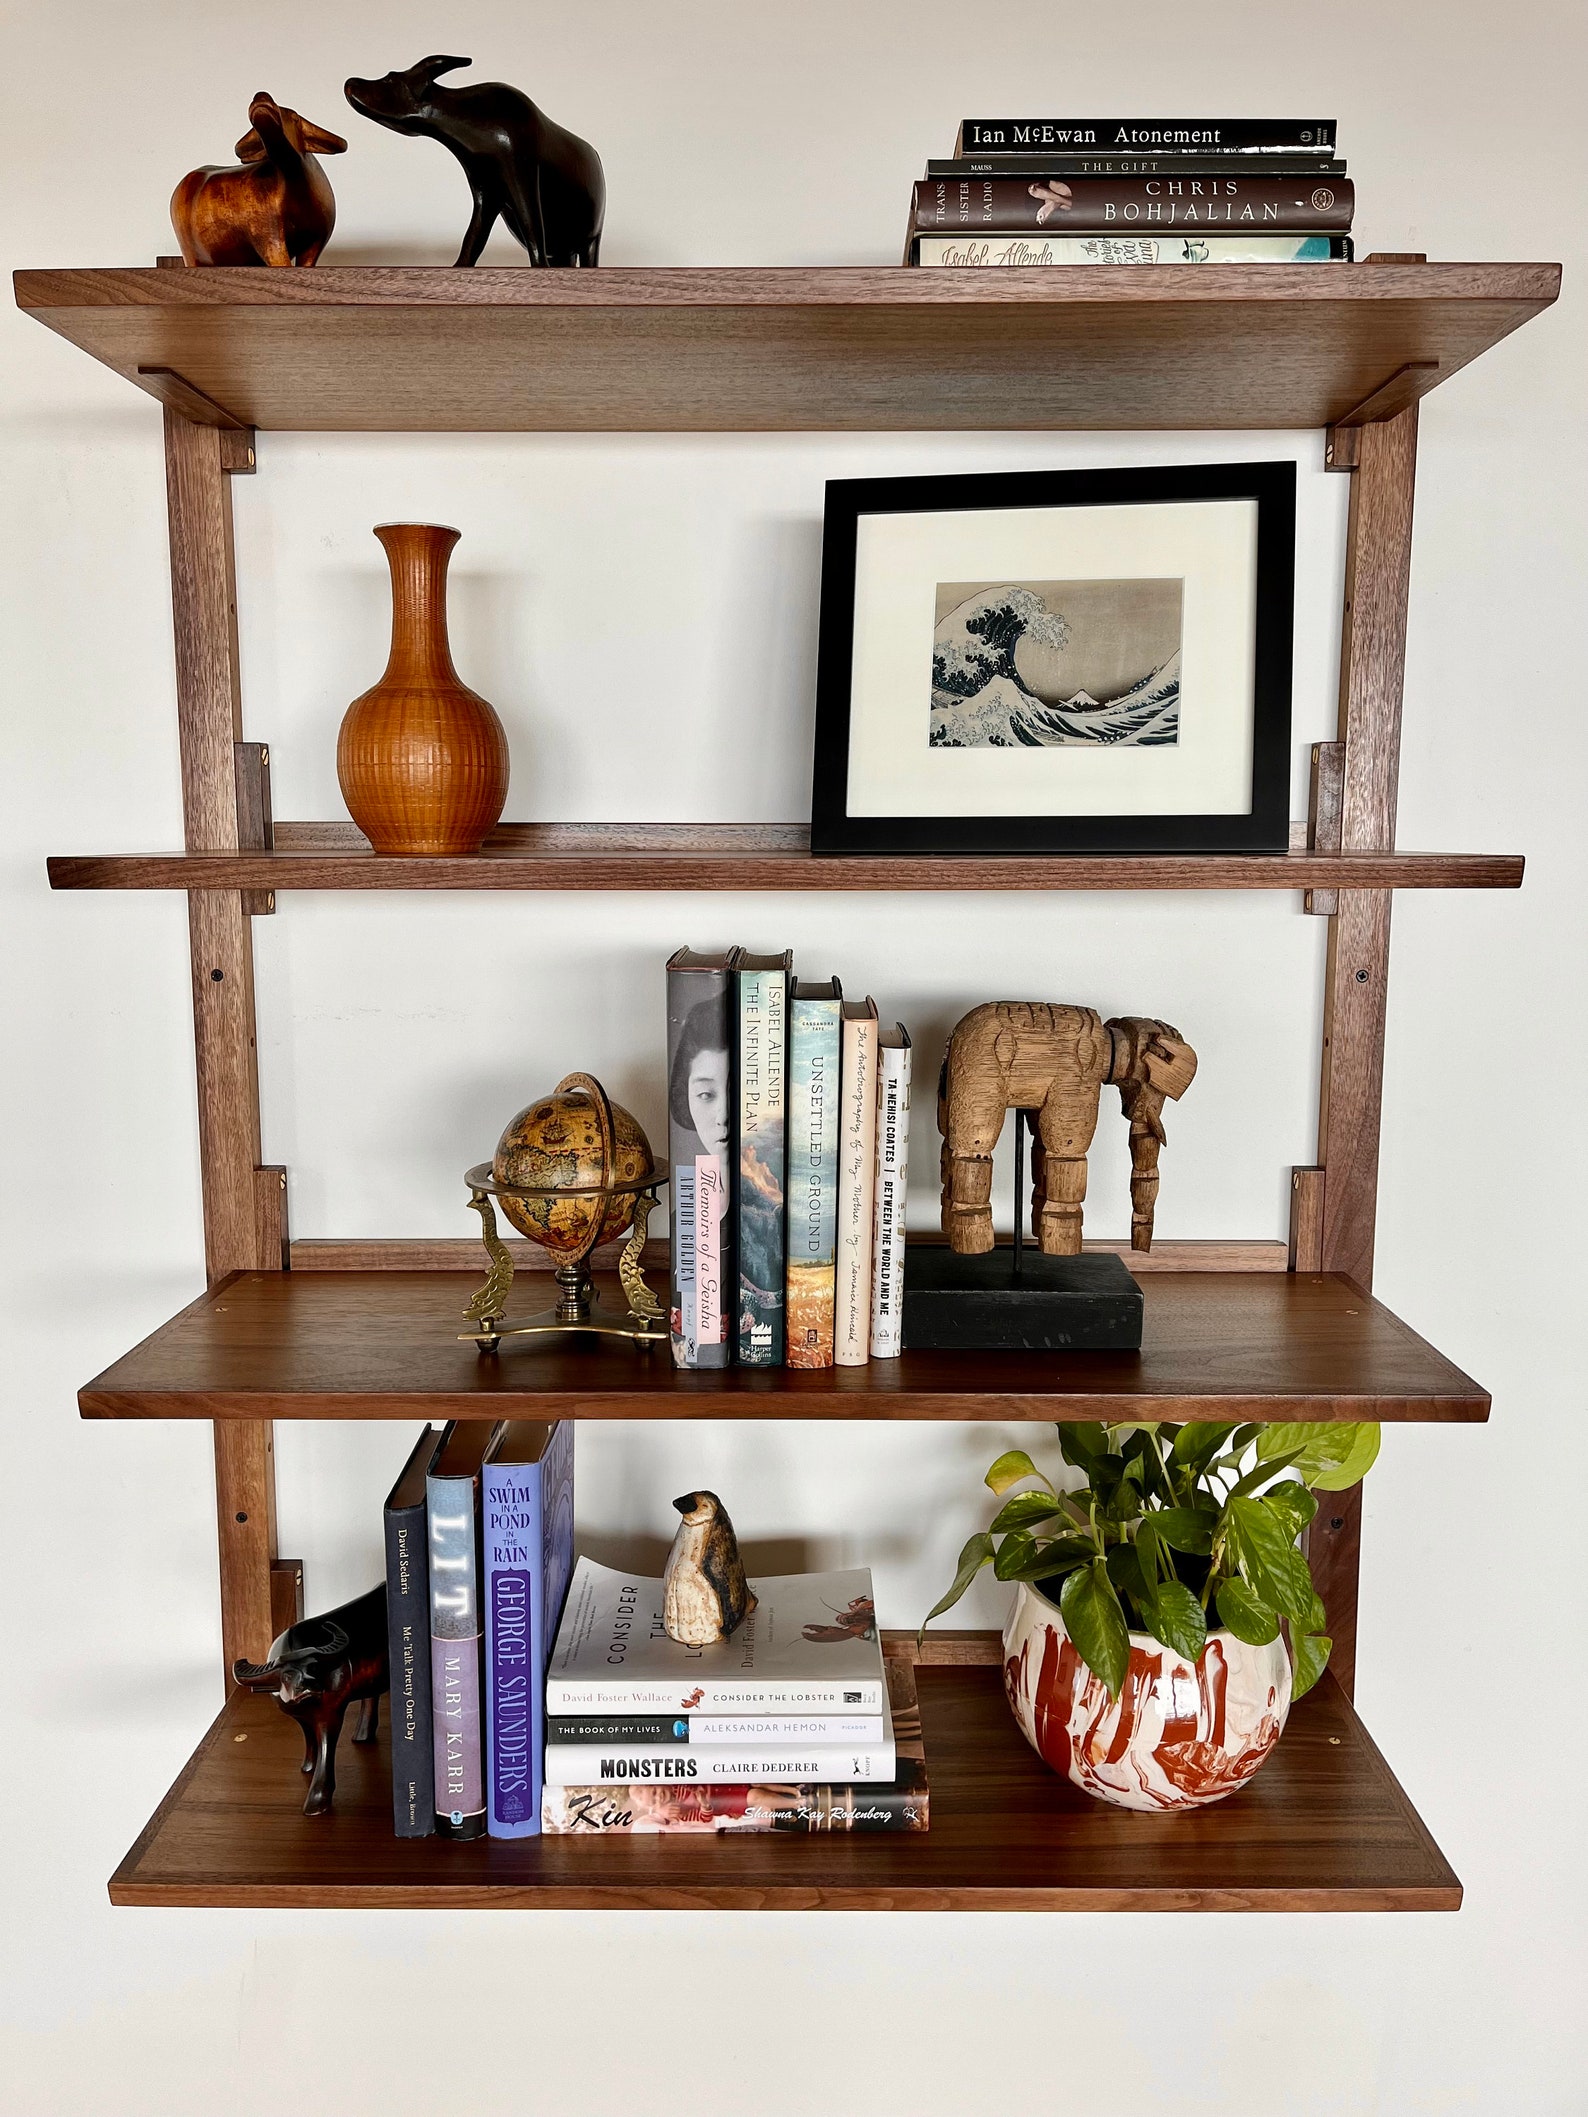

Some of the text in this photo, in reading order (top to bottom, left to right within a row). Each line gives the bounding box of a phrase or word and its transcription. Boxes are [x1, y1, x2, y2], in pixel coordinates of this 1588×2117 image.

[973, 126, 1221, 143] Ian McEwan Atonement
[1082, 162, 1158, 171] THE GIFT
[1146, 181, 1237, 195] CHRIS
[960, 182, 969, 222] SISTER
[983, 182, 993, 222] RADIO
[1104, 203, 1279, 224] BOHJALIAN
[994, 242, 1053, 266] Allende
[768, 986, 783, 1107] ISABEL ALLENDE
[857, 1027, 867, 1048] The
[745, 983, 760, 1132] THE INFINITE PLAN
[849, 1050, 868, 1133] Autobiography
[808, 1056, 824, 1252] UNSETTLED GROUND
[849, 1139, 864, 1152] of
[848, 1156, 864, 1181] My
[852, 1185, 862, 1225] Mother
[879, 1078, 897, 1316] TA-NEHISI COATES BETWEEN THE WORLD AND ME
[680, 1176, 695, 1282] ARTHUR GOLDEN
[696, 1168, 718, 1329] Memoirs of a Geisha
[846, 1230, 862, 1256] by
[850, 1260, 861, 1303] Jamaica
[489, 1487, 530, 1503] SWIM
[505, 1478, 513, 1487] A
[501, 1504, 519, 1513] IN A
[490, 1513, 530, 1530] POND
[398, 1528, 410, 1595] David Sedaris
[433, 1514, 469, 1615] LIT
[493, 1546, 528, 1563] RAIN
[607, 1586, 638, 1664] CONSIDER
[743, 1618, 756, 1641] Foster
[741, 1644, 754, 1668] David
[403, 1626, 416, 1741] Me Talk Pretty One Day
[496, 1577, 528, 1794] GEORGE SAUNDERS
[562, 1693, 673, 1702] David Foster Wallace
[445, 1656, 464, 1794] MARY KARR
[704, 1723, 827, 1732] ALEKSANDAR HEMON
[600, 1758, 698, 1778] MONSTERS
[712, 1763, 819, 1773] CLAIRE DEDERER
[568, 1794, 634, 1829] Kin
[742, 1805, 892, 1823] Shawna Kay Rodenberg
